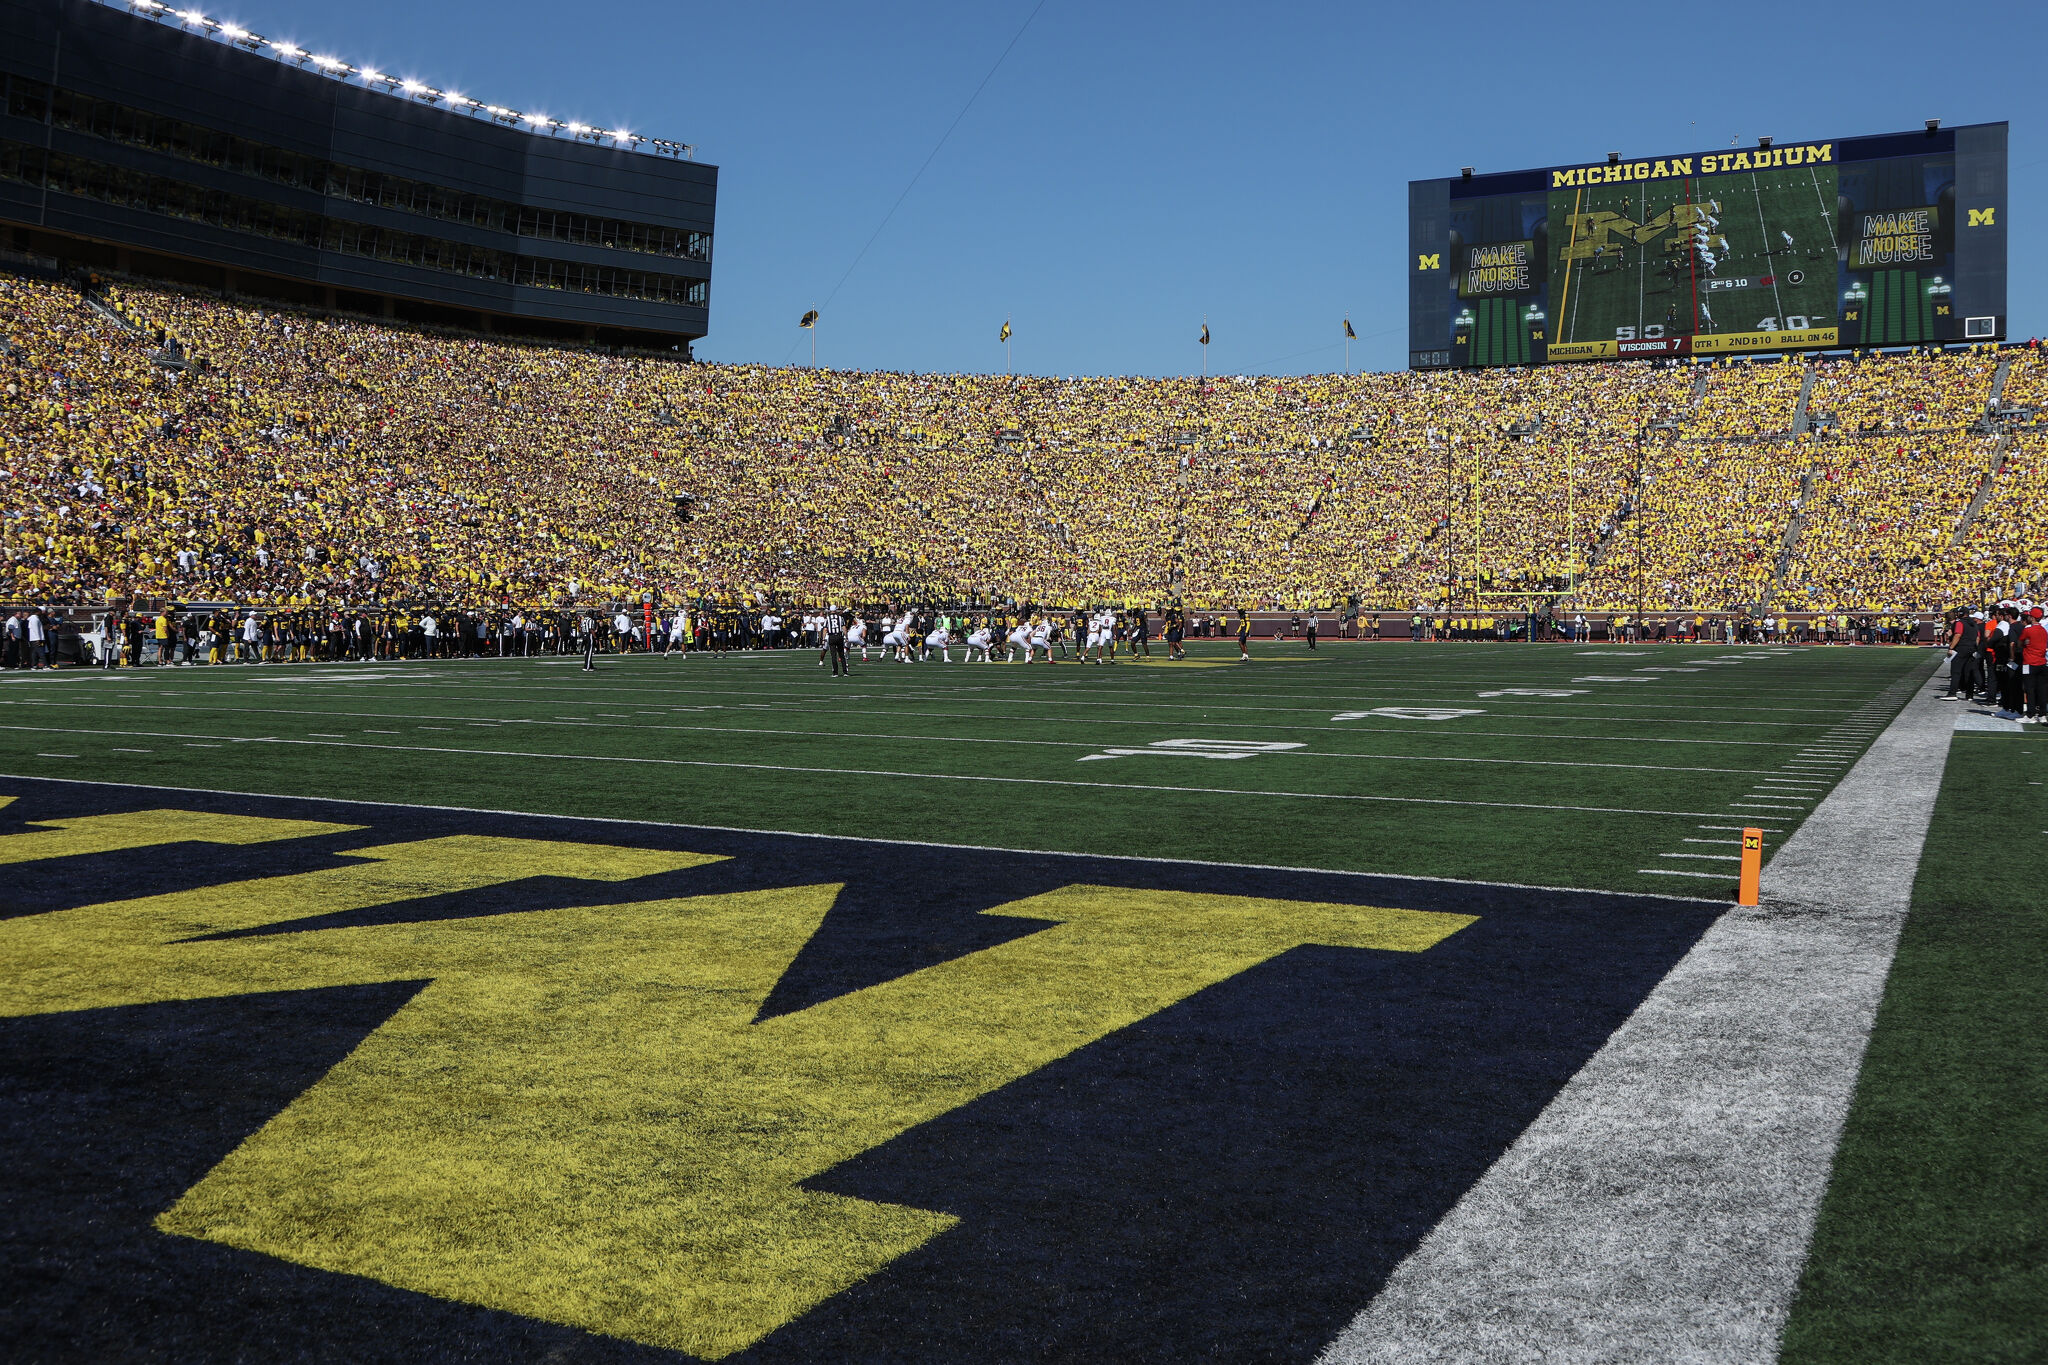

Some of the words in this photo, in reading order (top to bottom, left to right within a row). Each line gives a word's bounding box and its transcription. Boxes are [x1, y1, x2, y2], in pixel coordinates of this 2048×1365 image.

[1552, 158, 1693, 188] MICHIGAN
[1701, 143, 1832, 173] STADIUM
[1863, 210, 1929, 237] MAKE
[1967, 207, 1995, 227] M
[1875, 219, 1916, 235] MAKE
[1859, 235, 1933, 264] NOISE
[1873, 235, 1919, 252] NOISE
[1419, 253, 1440, 270] M
[1471, 244, 1526, 268] MAKE
[1481, 251, 1515, 266] MAKE
[1467, 266, 1529, 293] NOISE
[1479, 265, 1518, 282] NOISE
[1734, 278, 1748, 287] 10
[1845, 311, 1857, 321] M
[1937, 305, 1949, 315] M
[1456, 335, 1466, 344] M
[1533, 331, 1543, 340] M
[1781, 335, 1804, 343] BALL
[1807, 333, 1820, 342] ON
[1822, 332, 1835, 341] 46
[1549, 345, 1593, 356] MICHIGAN
[1600, 343, 1608, 354] 7
[1619, 341, 1667, 352] WISCONSIN
[1673, 338, 1682, 350] 7
[831, 619, 839, 628] R
[1745, 838, 1758, 848] M
